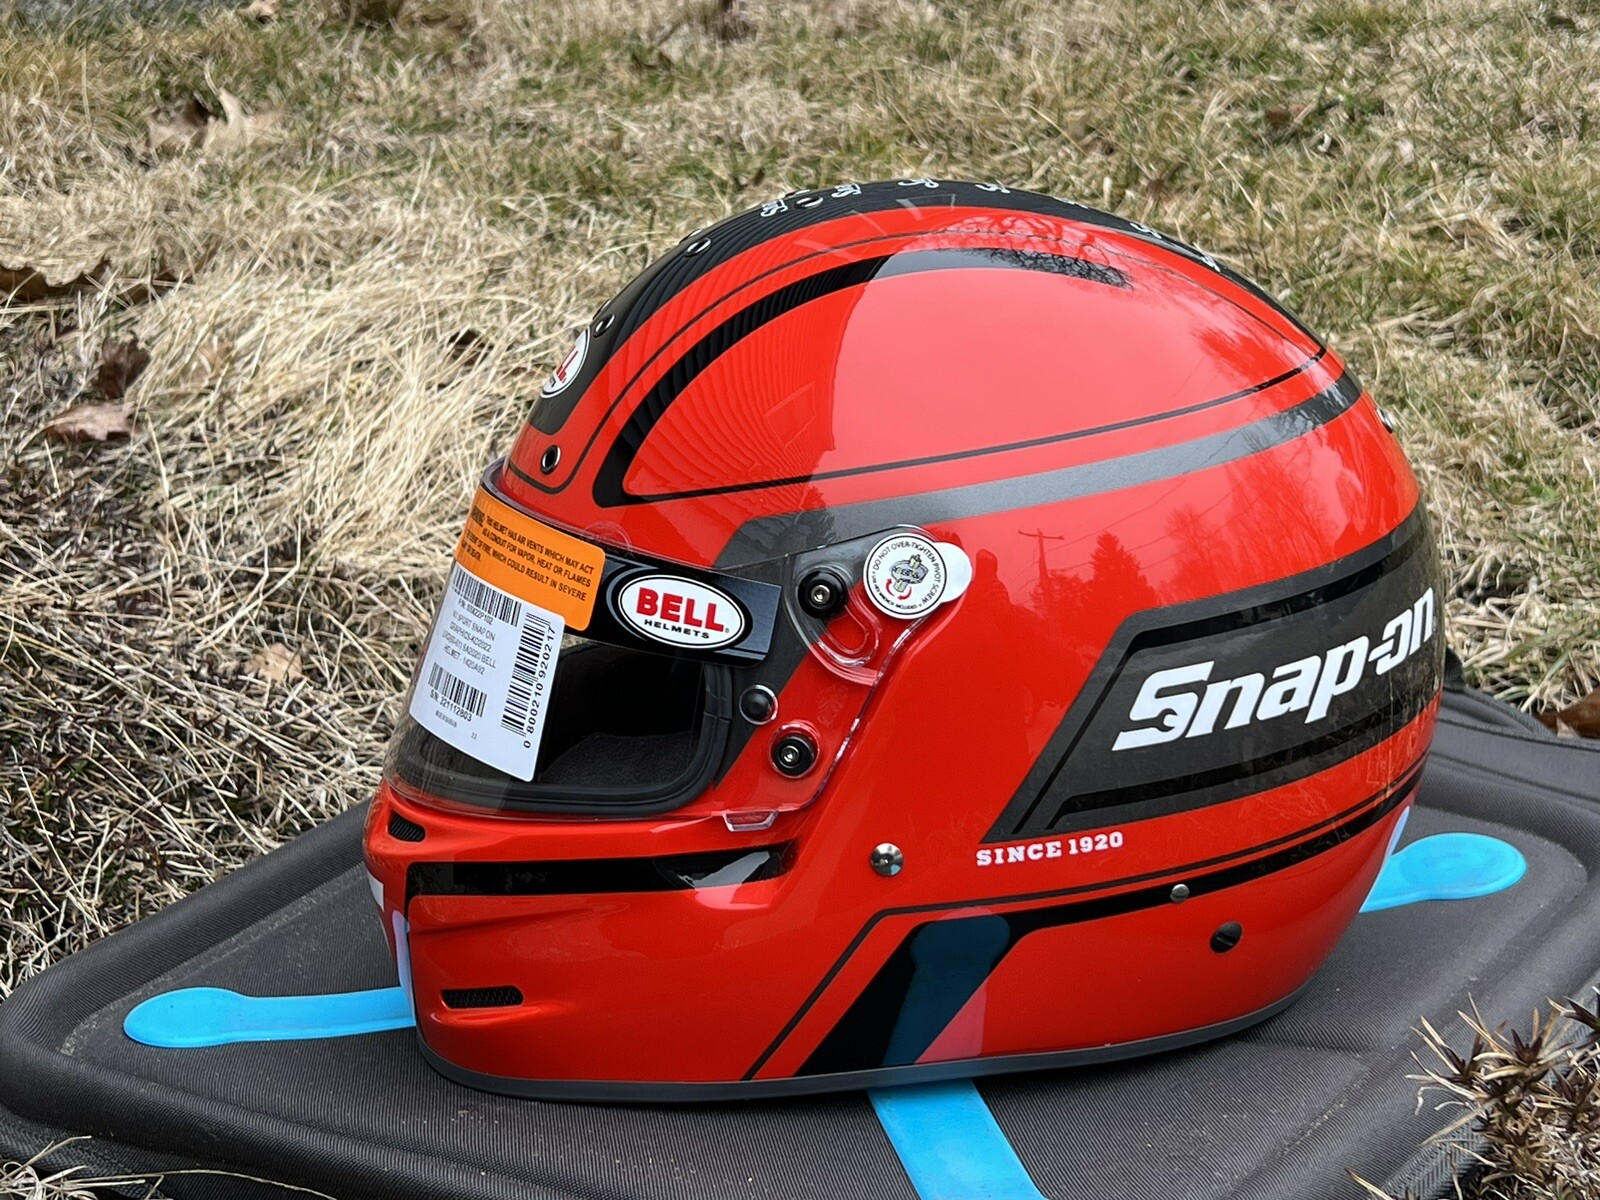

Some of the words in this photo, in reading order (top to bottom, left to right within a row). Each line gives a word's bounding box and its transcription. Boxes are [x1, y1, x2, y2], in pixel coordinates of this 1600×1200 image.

[493, 520, 508, 535] HELMET
[508, 529, 517, 540] HAS
[517, 534, 526, 545] AIR
[526, 539, 544, 554] VENTS
[544, 547, 565, 563] WHICH
[565, 556, 580, 568] MAY
[579, 563, 594, 575] ACT
[878, 546, 891, 560] NOT
[507, 542, 517, 554] FOR
[517, 548, 536, 565] VAPOR,
[536, 557, 553, 571] HEAT
[553, 565, 563, 576] OR
[563, 570, 592, 588] FLAMES
[873, 558, 882, 570] DO
[932, 562, 942, 584] PIVOT
[507, 558, 526, 574] COULD
[525, 567, 549, 585] RESULT
[549, 579, 558, 589] IN
[558, 583, 587, 601] SEVERE
[921, 583, 940, 605] SCREW
[636, 587, 724, 632] BELL
[485, 630, 496, 641] ON
[644, 619, 710, 639] HELMETS
[481, 653, 496, 669] BELL
[538, 626, 556, 678] 920217
[1112, 587, 1434, 751] Snap-on
[526, 683, 544, 734] 800210
[523, 740, 532, 749] 0
[976, 841, 1062, 867] SINCE
[1068, 831, 1124, 855] 1920
